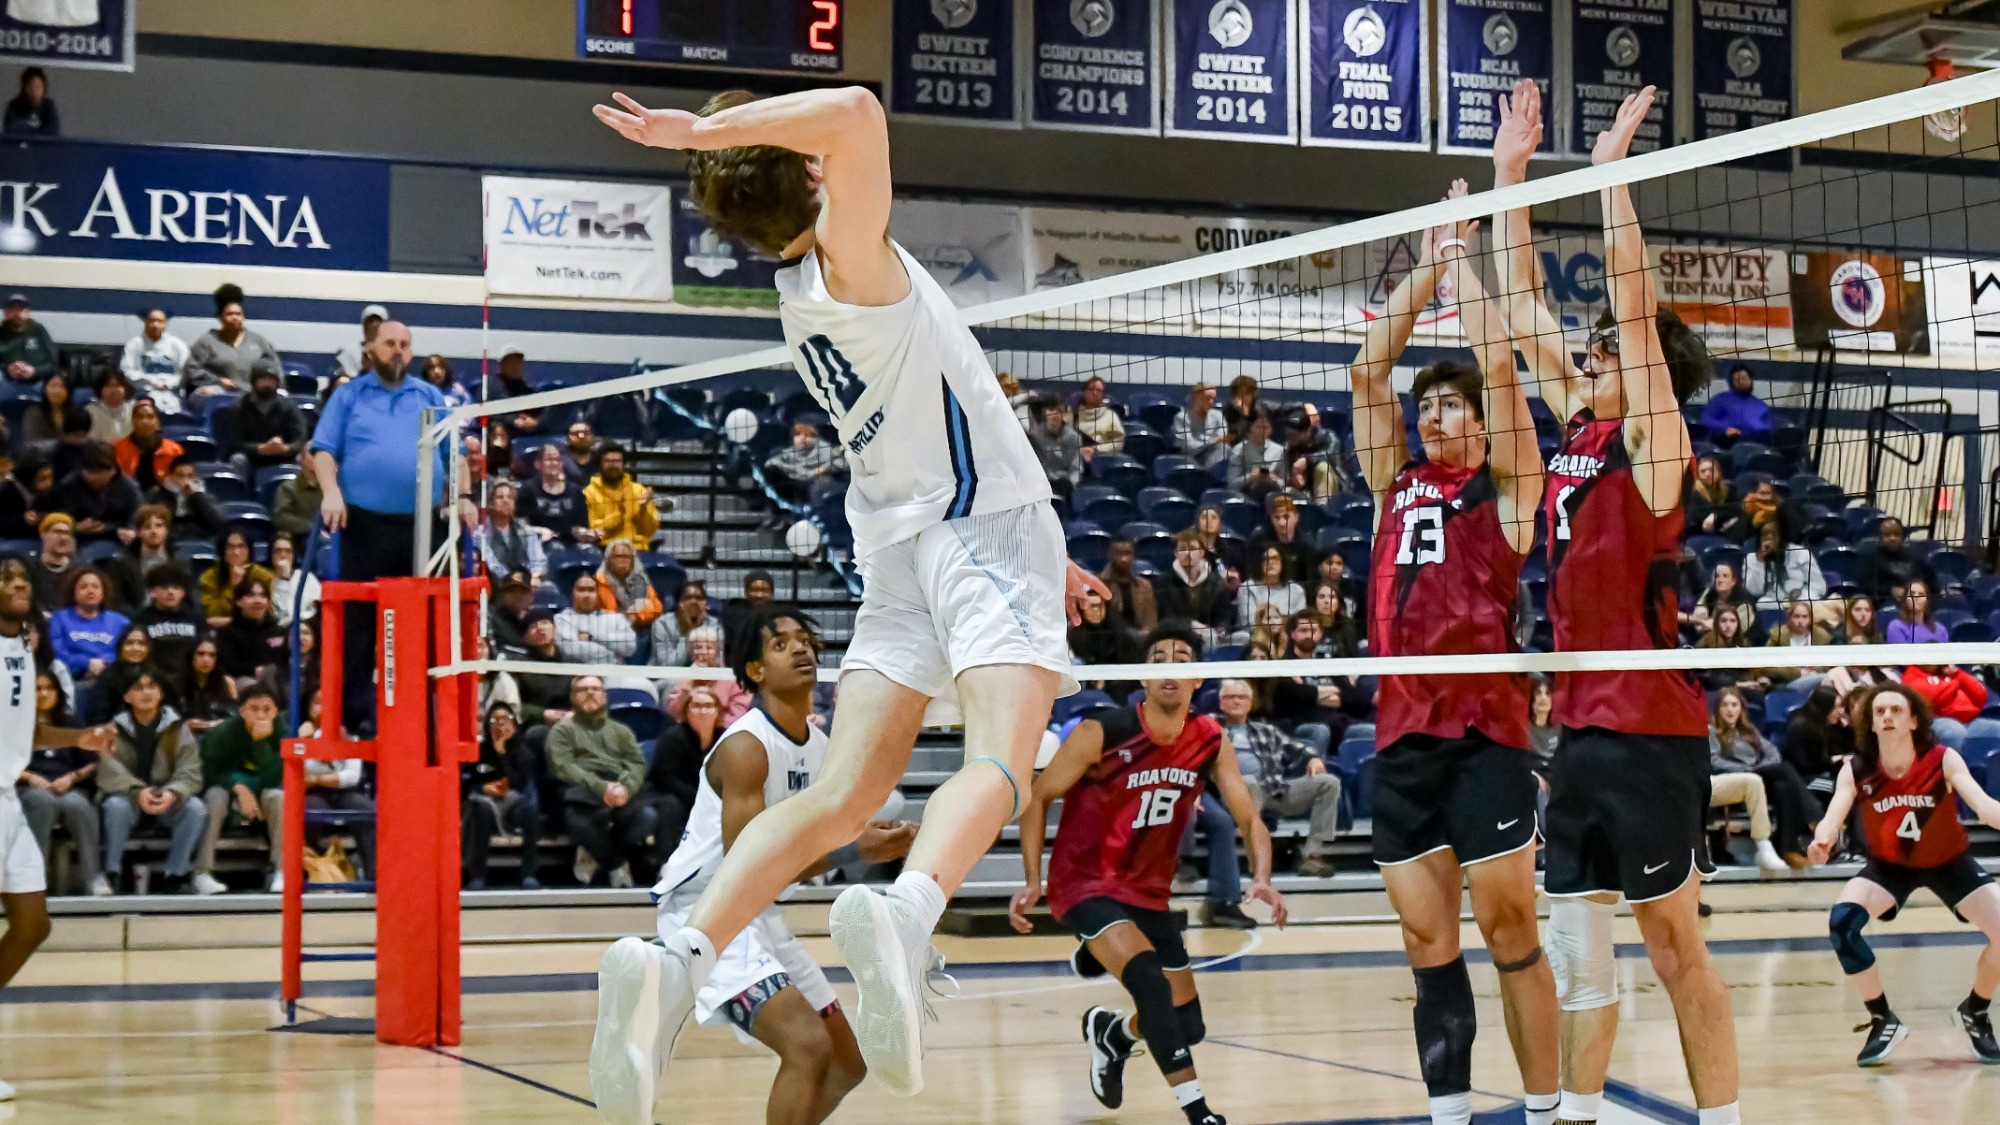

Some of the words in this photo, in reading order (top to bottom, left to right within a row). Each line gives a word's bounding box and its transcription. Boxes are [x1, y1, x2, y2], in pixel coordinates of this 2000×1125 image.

[810, 1, 837, 50] 2
[586, 39, 635, 55] SCORE
[683, 47, 728, 62] MATCH
[918, 34, 990, 56] SWEET
[1039, 43, 1145, 67] CONFERENCE
[791, 54, 839, 69] SCORE
[911, 54, 997, 77] SIXTEEN
[1198, 52, 1266, 74] SWEET
[1339, 61, 1392, 82] FINAL
[1480, 58, 1520, 76] NCAA
[1039, 62, 1145, 86] CHAMPIONS
[1192, 72, 1273, 94] SIXTEEN
[1450, 71, 1549, 94] TOURNAT
[1603, 69, 1642, 85] NCAA
[915, 78, 993, 109] 2013
[1343, 81, 1390, 101] FOUR
[1725, 79, 1762, 97] NCAA
[1056, 87, 1129, 116] 2014
[1196, 95, 1267, 124] 2014
[1697, 93, 1788, 115] TOURNAMENT
[1332, 103, 1402, 132] 2015
[0, 181, 60, 236] K
[68, 166, 332, 250] ARENA
[536, 266, 622, 282] NetTek.com
[1660, 251, 1773, 282] SPIVEY
[1664, 281, 1736, 297] RENTALS
[1556, 485, 1576, 540] 1
[1394, 506, 1446, 565] 13
[11, 676, 21, 707] 2
[1126, 767, 1198, 790] ROANOKE
[1131, 788, 1182, 829] 18
[1873, 794, 1936, 814] ROANOKE
[1896, 811, 1921, 842] 4
